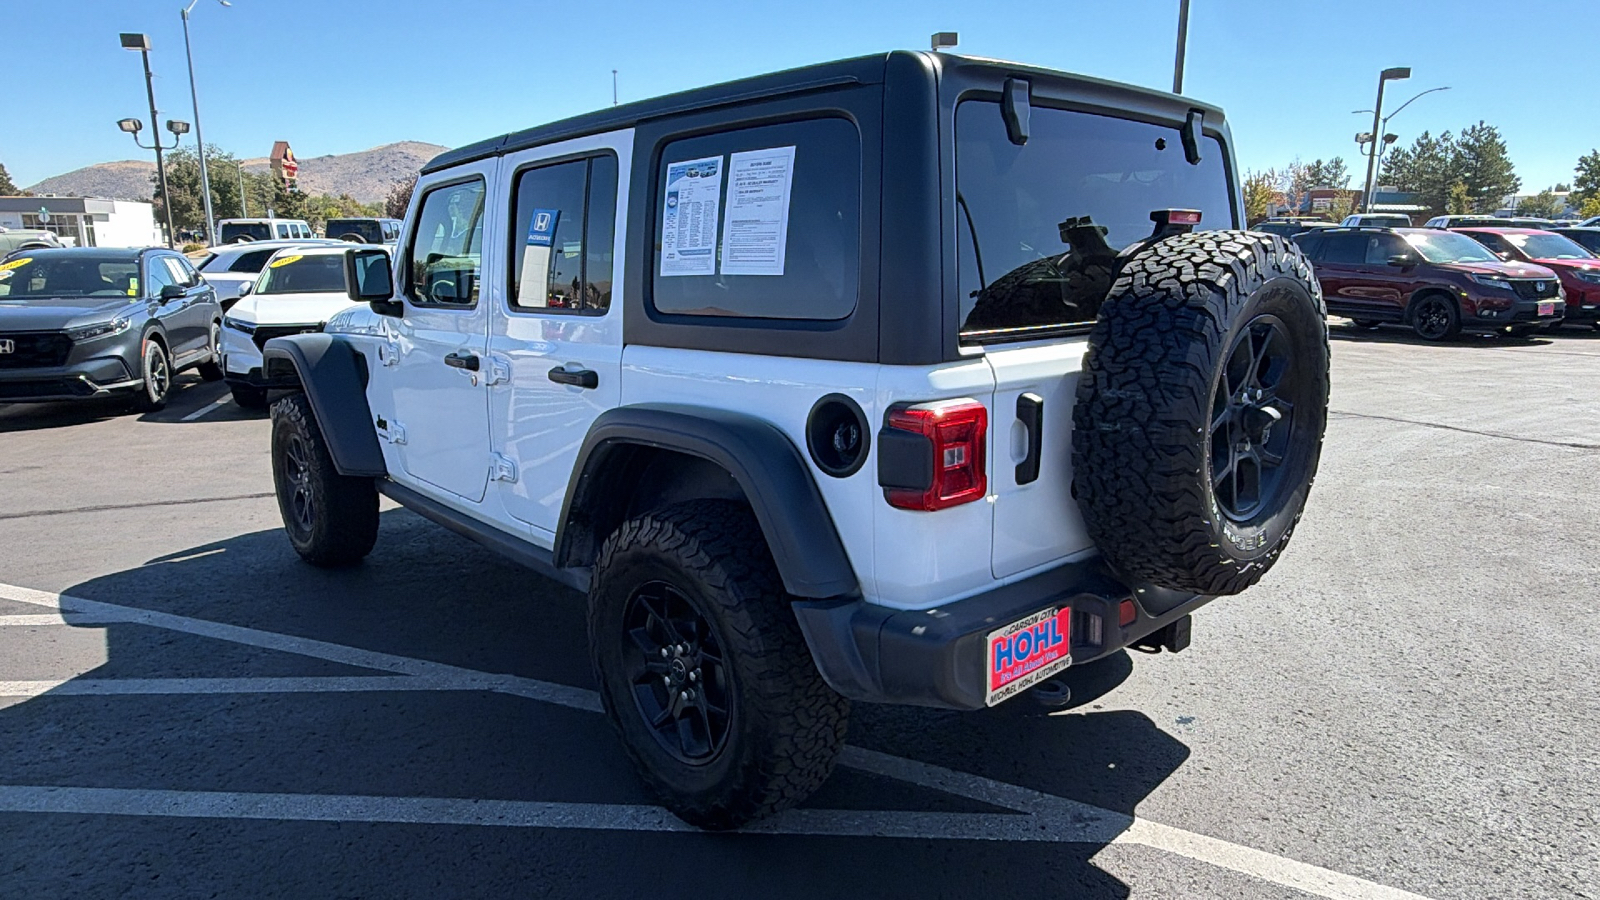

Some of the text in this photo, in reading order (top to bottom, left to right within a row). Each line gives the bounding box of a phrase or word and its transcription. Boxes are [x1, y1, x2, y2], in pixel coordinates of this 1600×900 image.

[1009, 613, 1039, 634] CARSON
[995, 618, 1063, 673] HOHL
[990, 656, 1070, 704] MICHAEL HOHL AUTOMOTIVE
[1013, 664, 1023, 677] All
[1024, 656, 1044, 672] About
